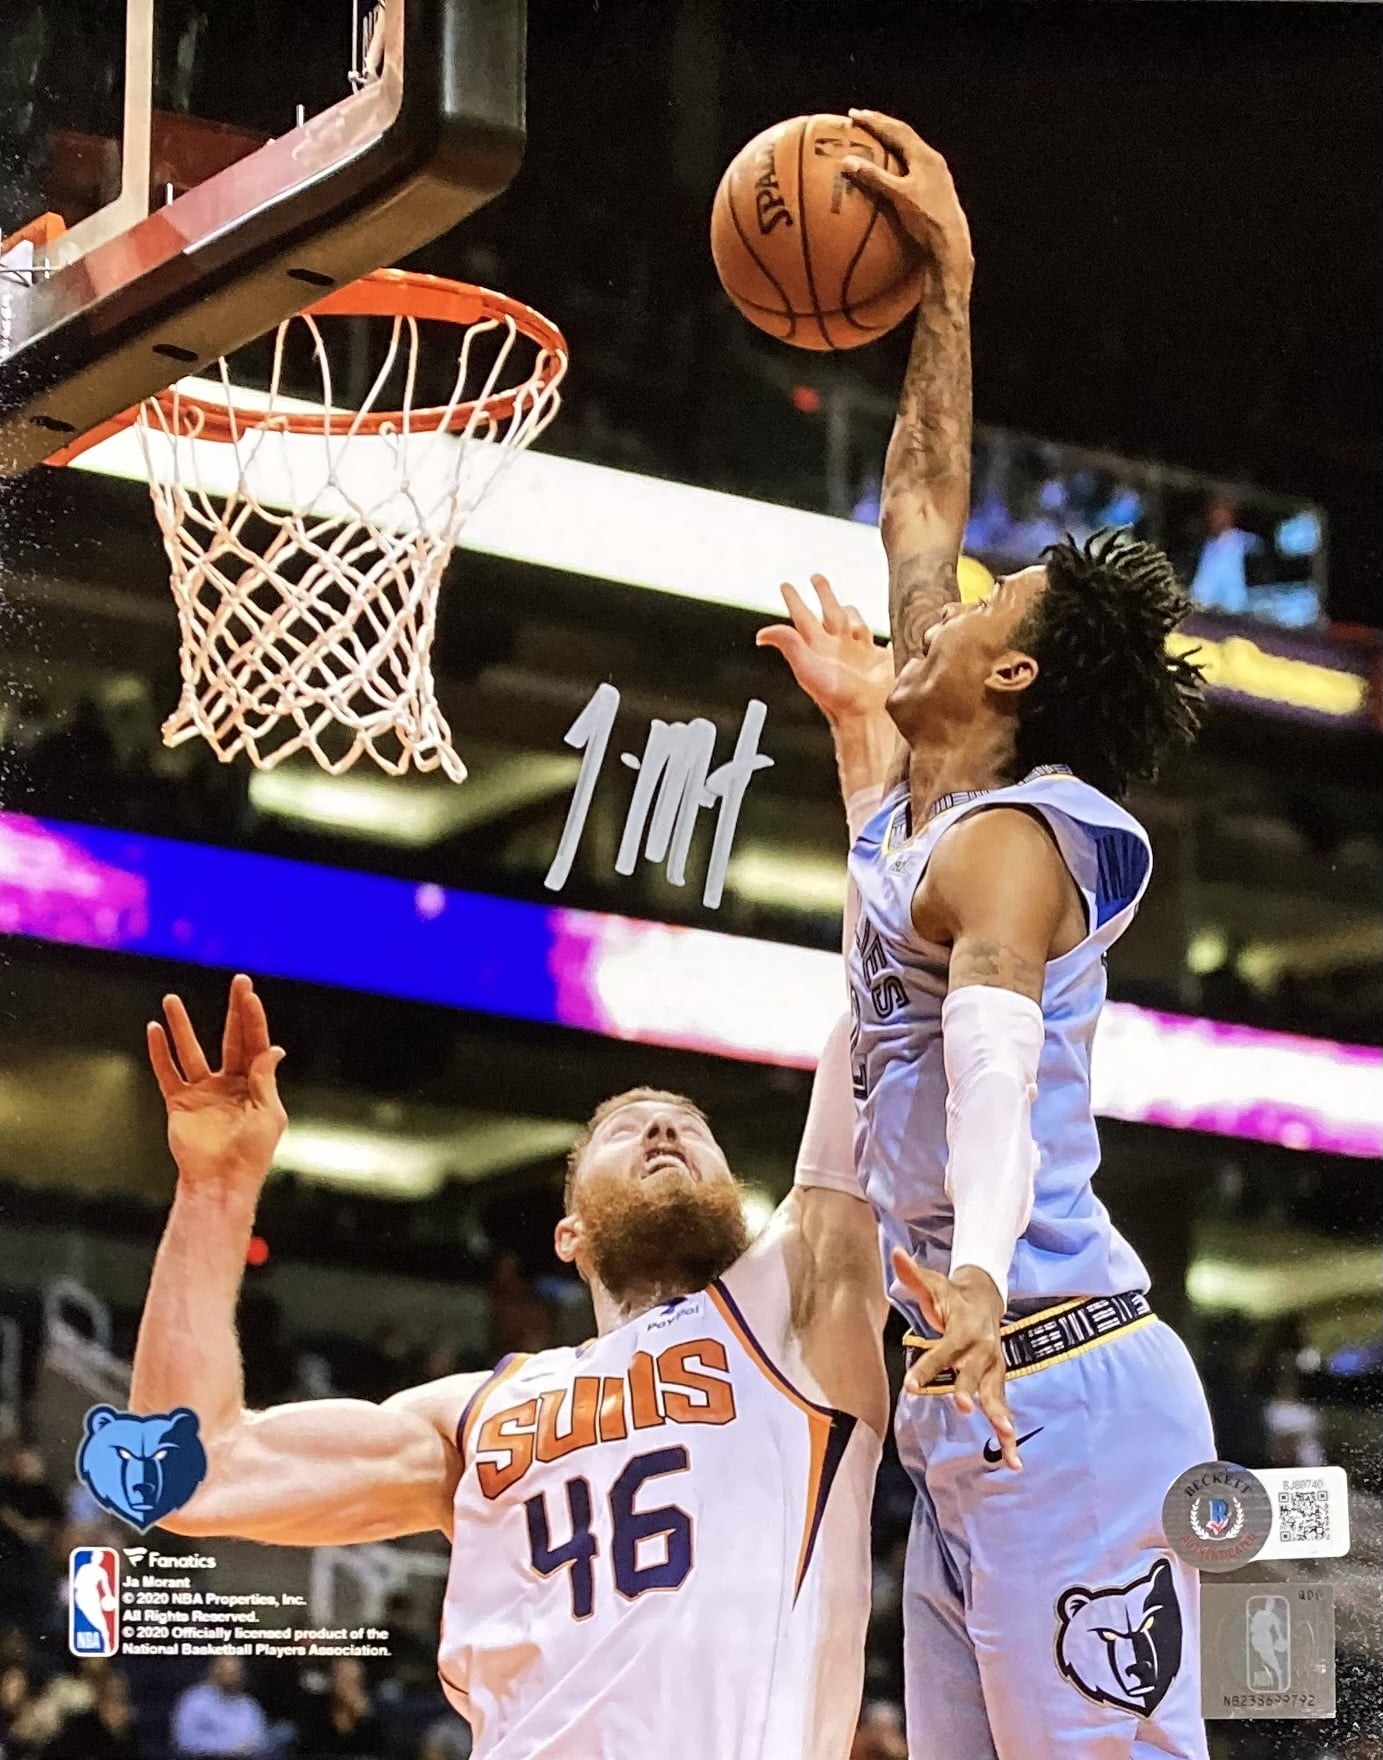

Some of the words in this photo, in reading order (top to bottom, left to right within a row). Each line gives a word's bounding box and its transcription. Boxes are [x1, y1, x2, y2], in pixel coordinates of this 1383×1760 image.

[475, 1337, 738, 1500] SUNS
[1184, 1471, 1254, 1497] BECKETT
[523, 1442, 695, 1623] 46
